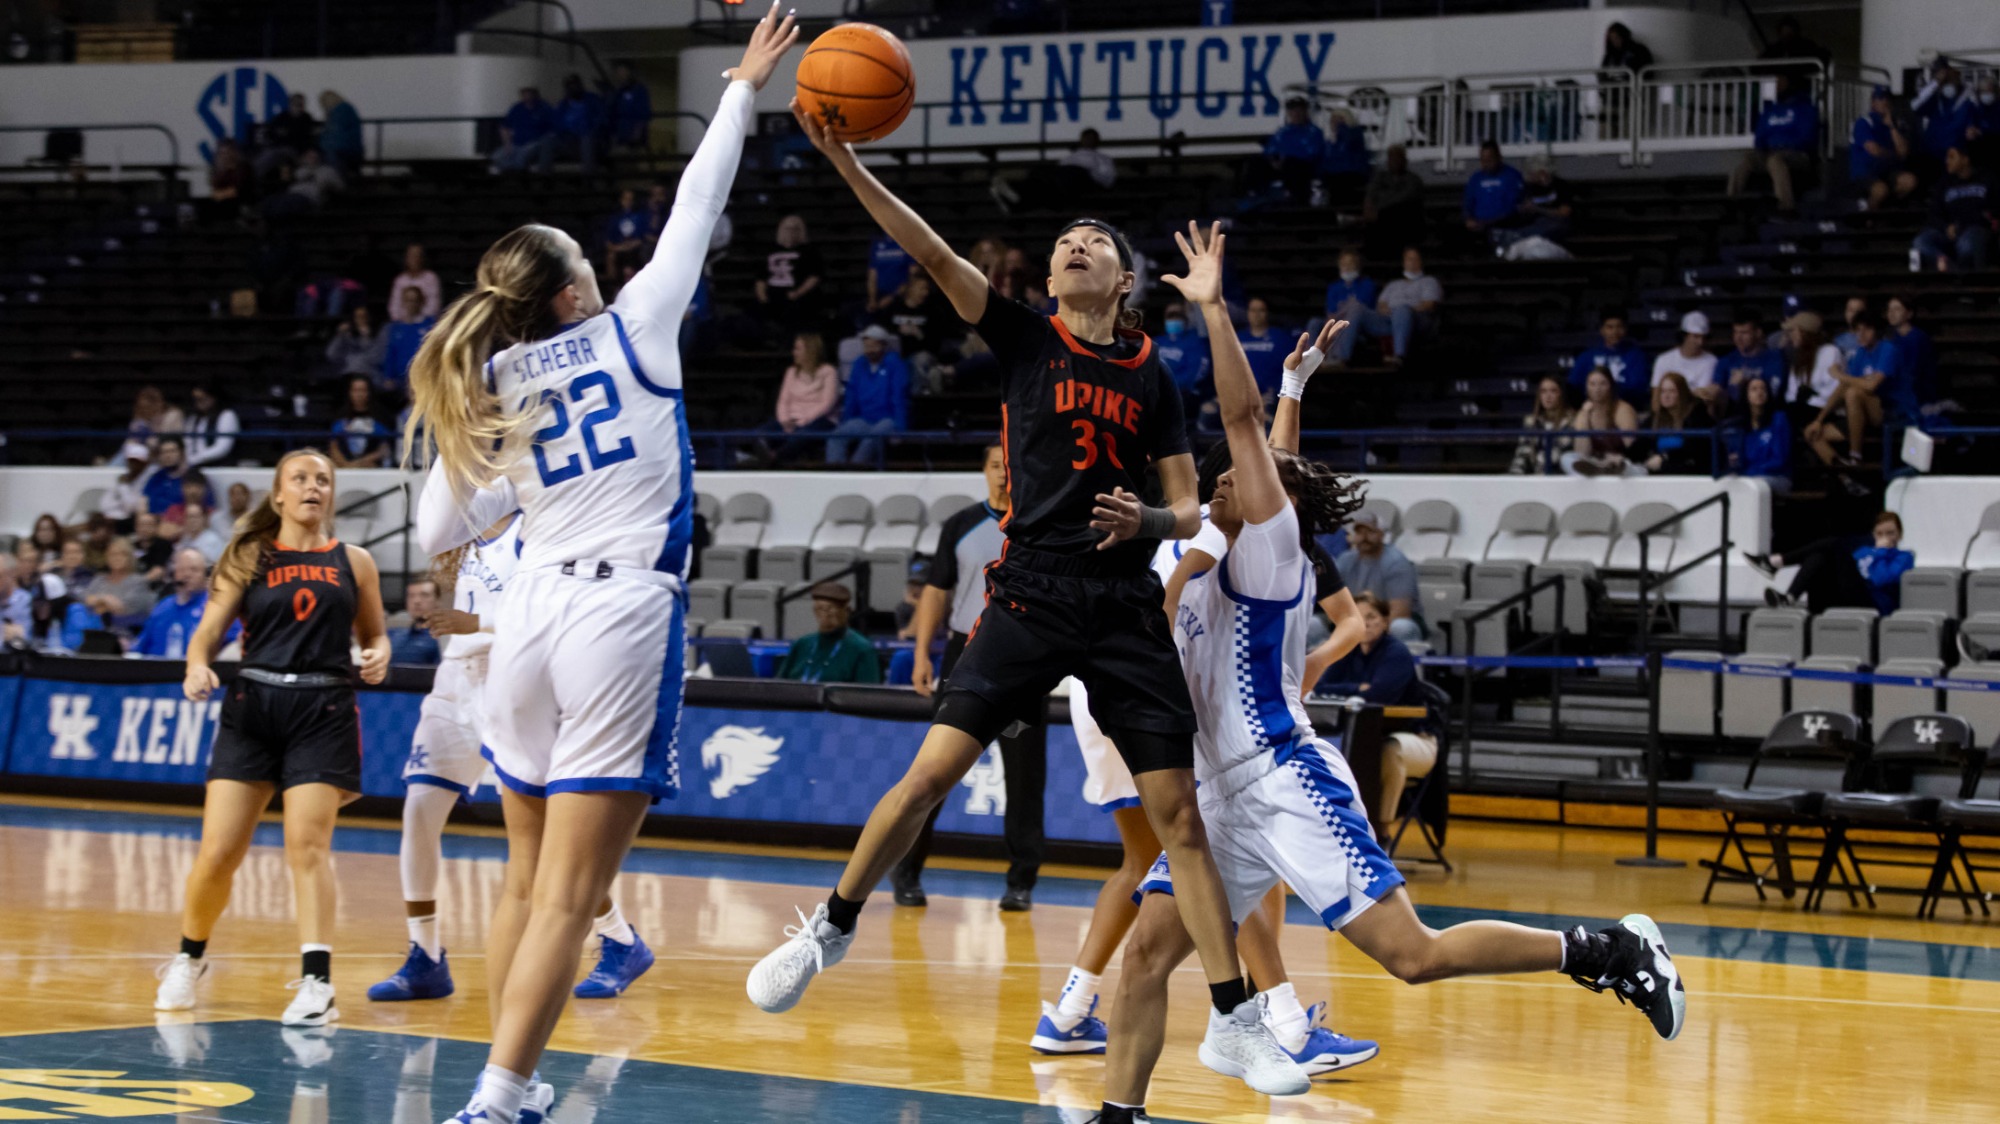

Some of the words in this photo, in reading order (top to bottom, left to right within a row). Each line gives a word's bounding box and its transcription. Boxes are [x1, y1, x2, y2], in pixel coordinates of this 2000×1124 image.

[948, 32, 1336, 125] KENTUCKY
[513, 337, 598, 383] SCHERR
[519, 370, 637, 488] 22
[1055, 379, 1143, 436] UPIKE
[267, 564, 341, 588] UPIKE
[293, 588, 317, 622] 0
